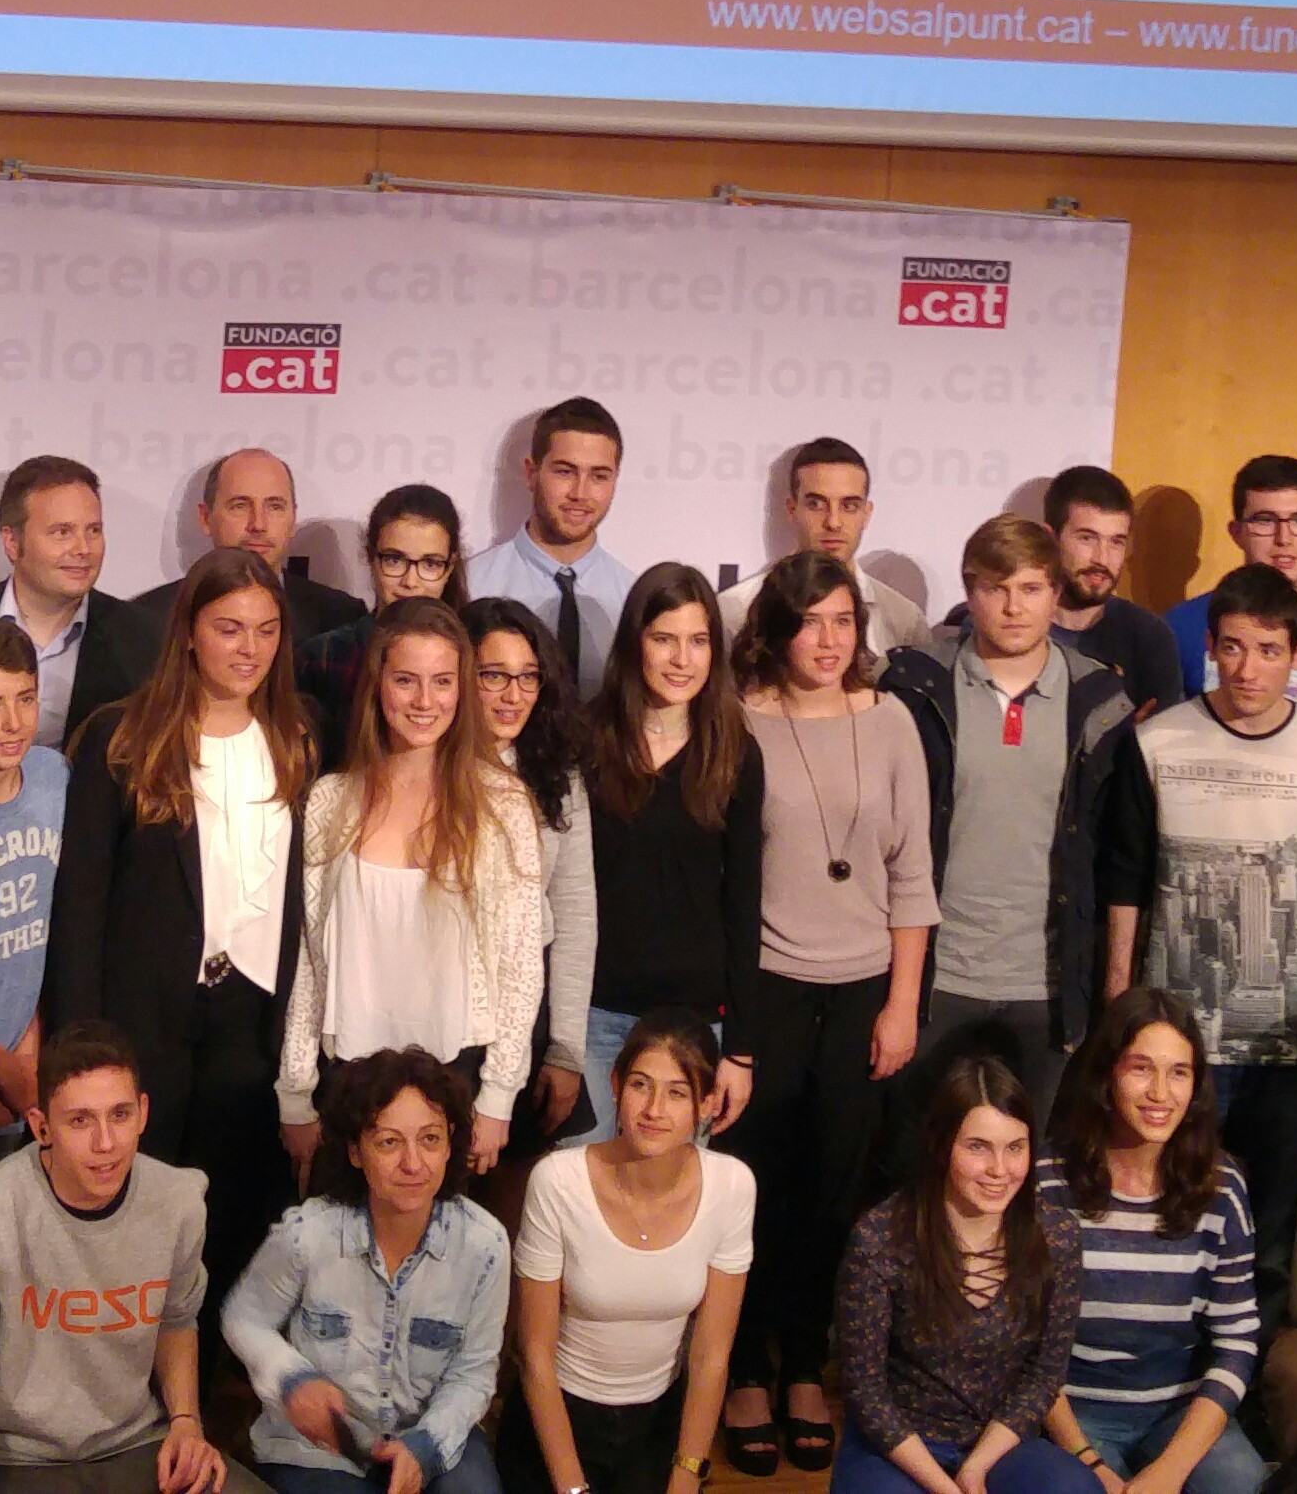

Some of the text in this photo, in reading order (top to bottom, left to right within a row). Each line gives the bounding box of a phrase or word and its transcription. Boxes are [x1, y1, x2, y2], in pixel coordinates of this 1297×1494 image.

[905, 261, 1008, 282] FUNDACIÓ
[903, 286, 1003, 325] .cat
[227, 324, 339, 347] FUNDACIÓ
[226, 348, 334, 392] .cat
